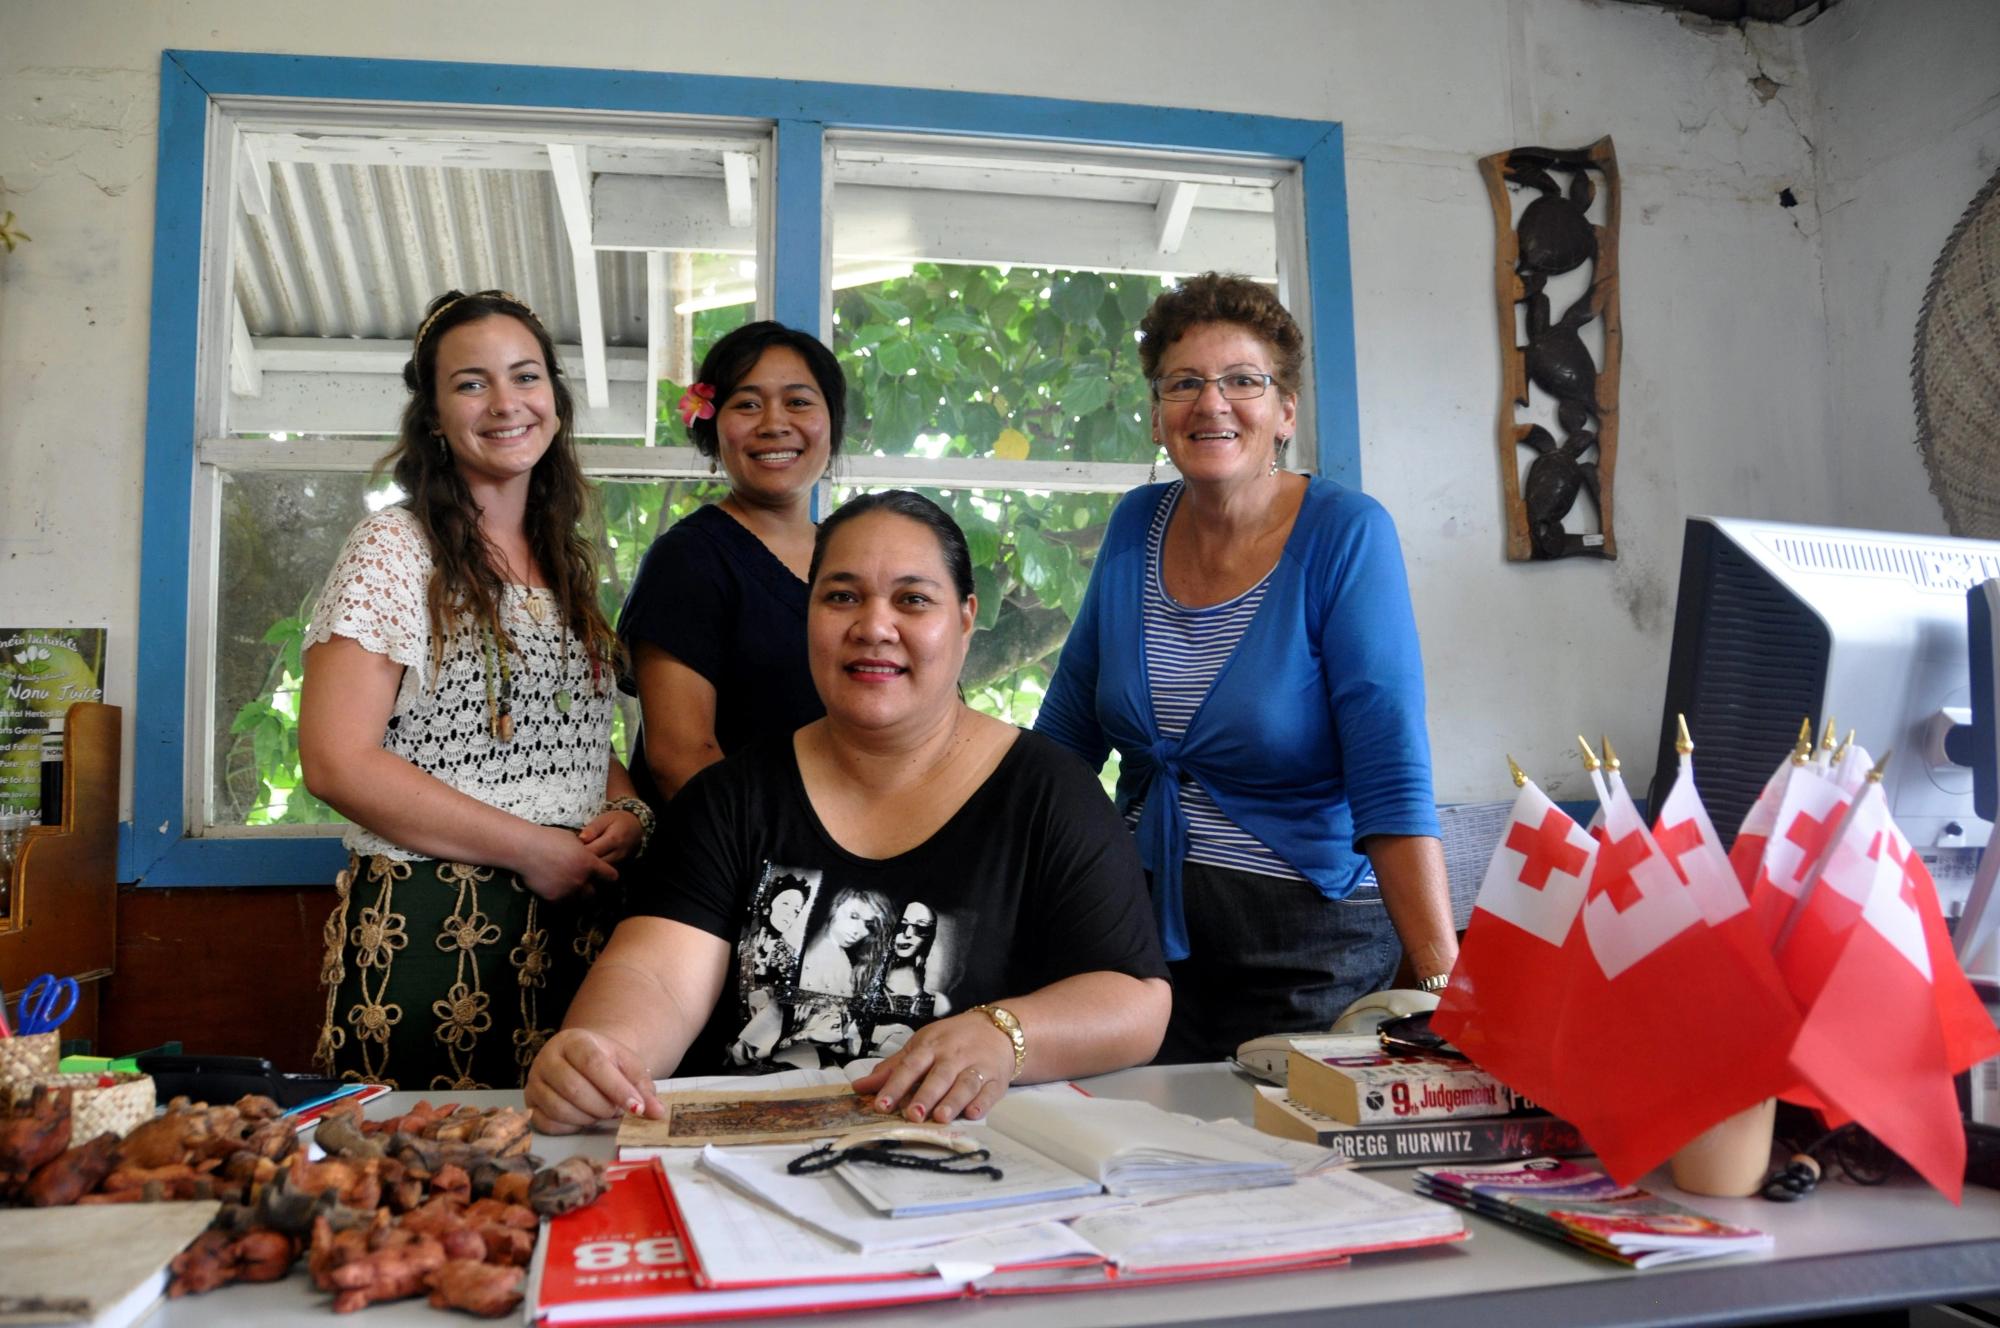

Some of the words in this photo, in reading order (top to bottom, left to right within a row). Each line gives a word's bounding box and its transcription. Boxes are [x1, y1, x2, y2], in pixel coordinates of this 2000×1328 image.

[6, 683, 49, 700] Nonu
[58, 684, 102, 700] Juice
[1421, 1083, 1497, 1112] Judgement
[1333, 1133, 1388, 1157] GREGG
[1396, 1131, 1473, 1154] HURWITZ
